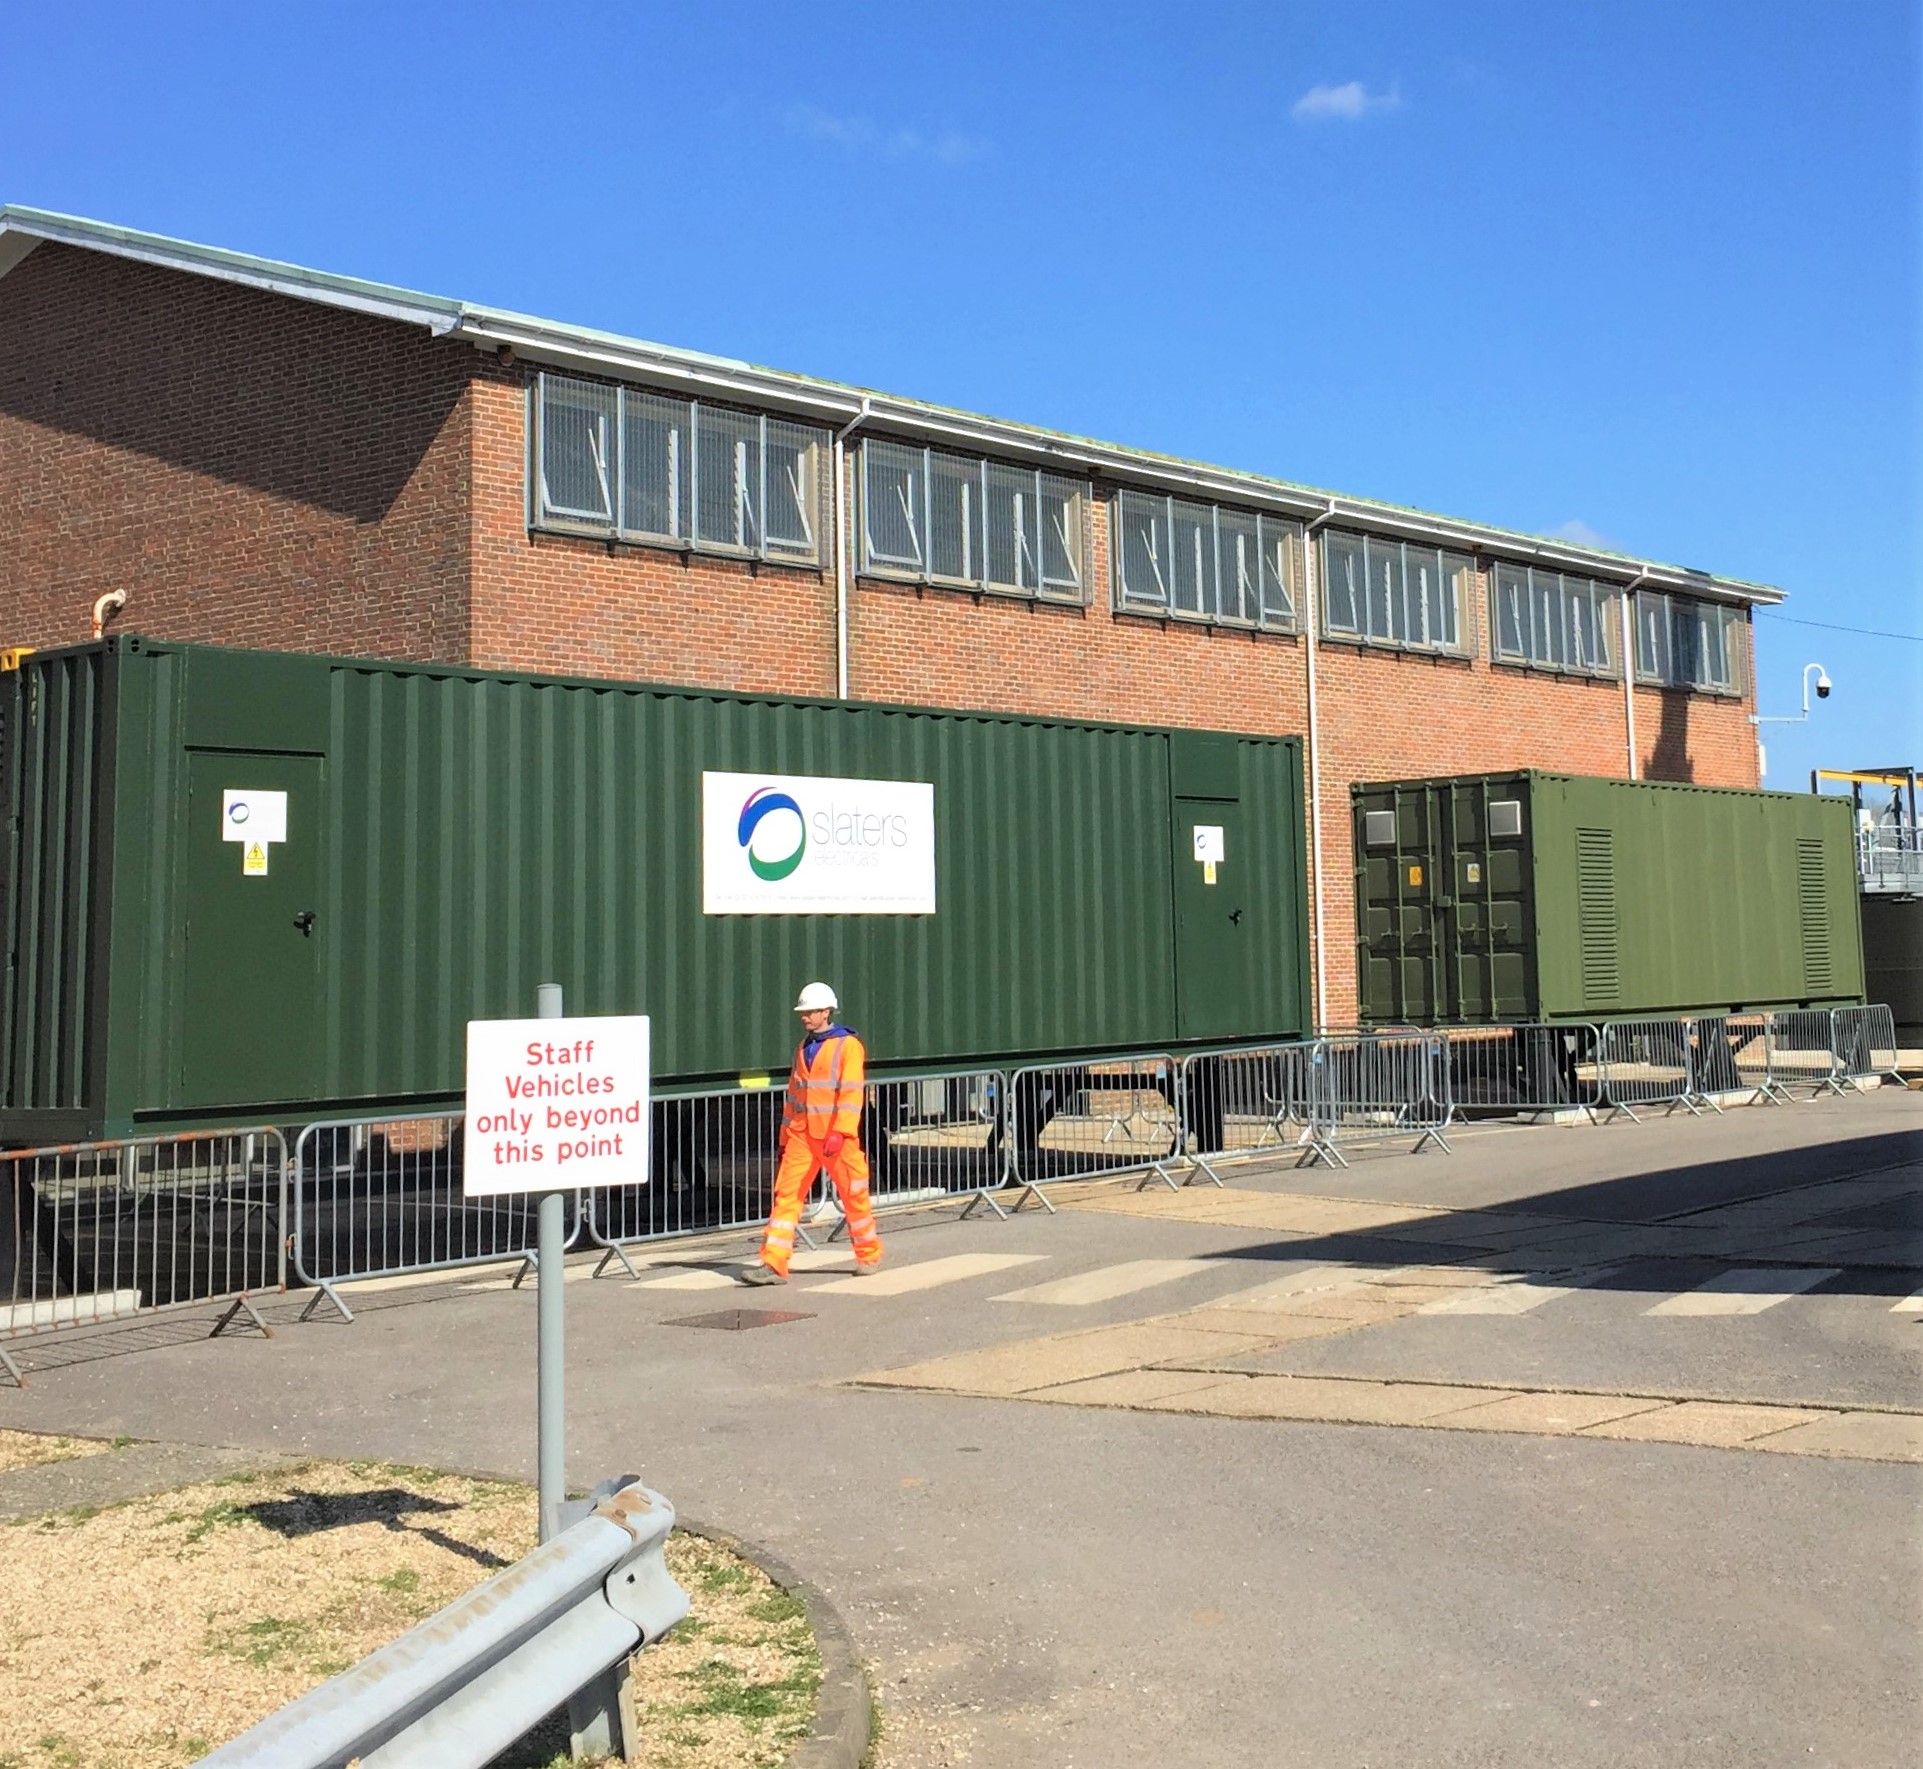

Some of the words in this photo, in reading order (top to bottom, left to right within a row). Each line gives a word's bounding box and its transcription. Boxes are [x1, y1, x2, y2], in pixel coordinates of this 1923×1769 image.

[812, 802, 908, 848] slaters
[814, 847, 879, 867] electricas
[526, 1040, 594, 1066] Staff
[505, 1072, 615, 1099] Vehicles
[477, 1107, 533, 1136] only
[546, 1100, 640, 1131] beyond
[494, 1139, 544, 1165] this
[557, 1133, 623, 1165] point
